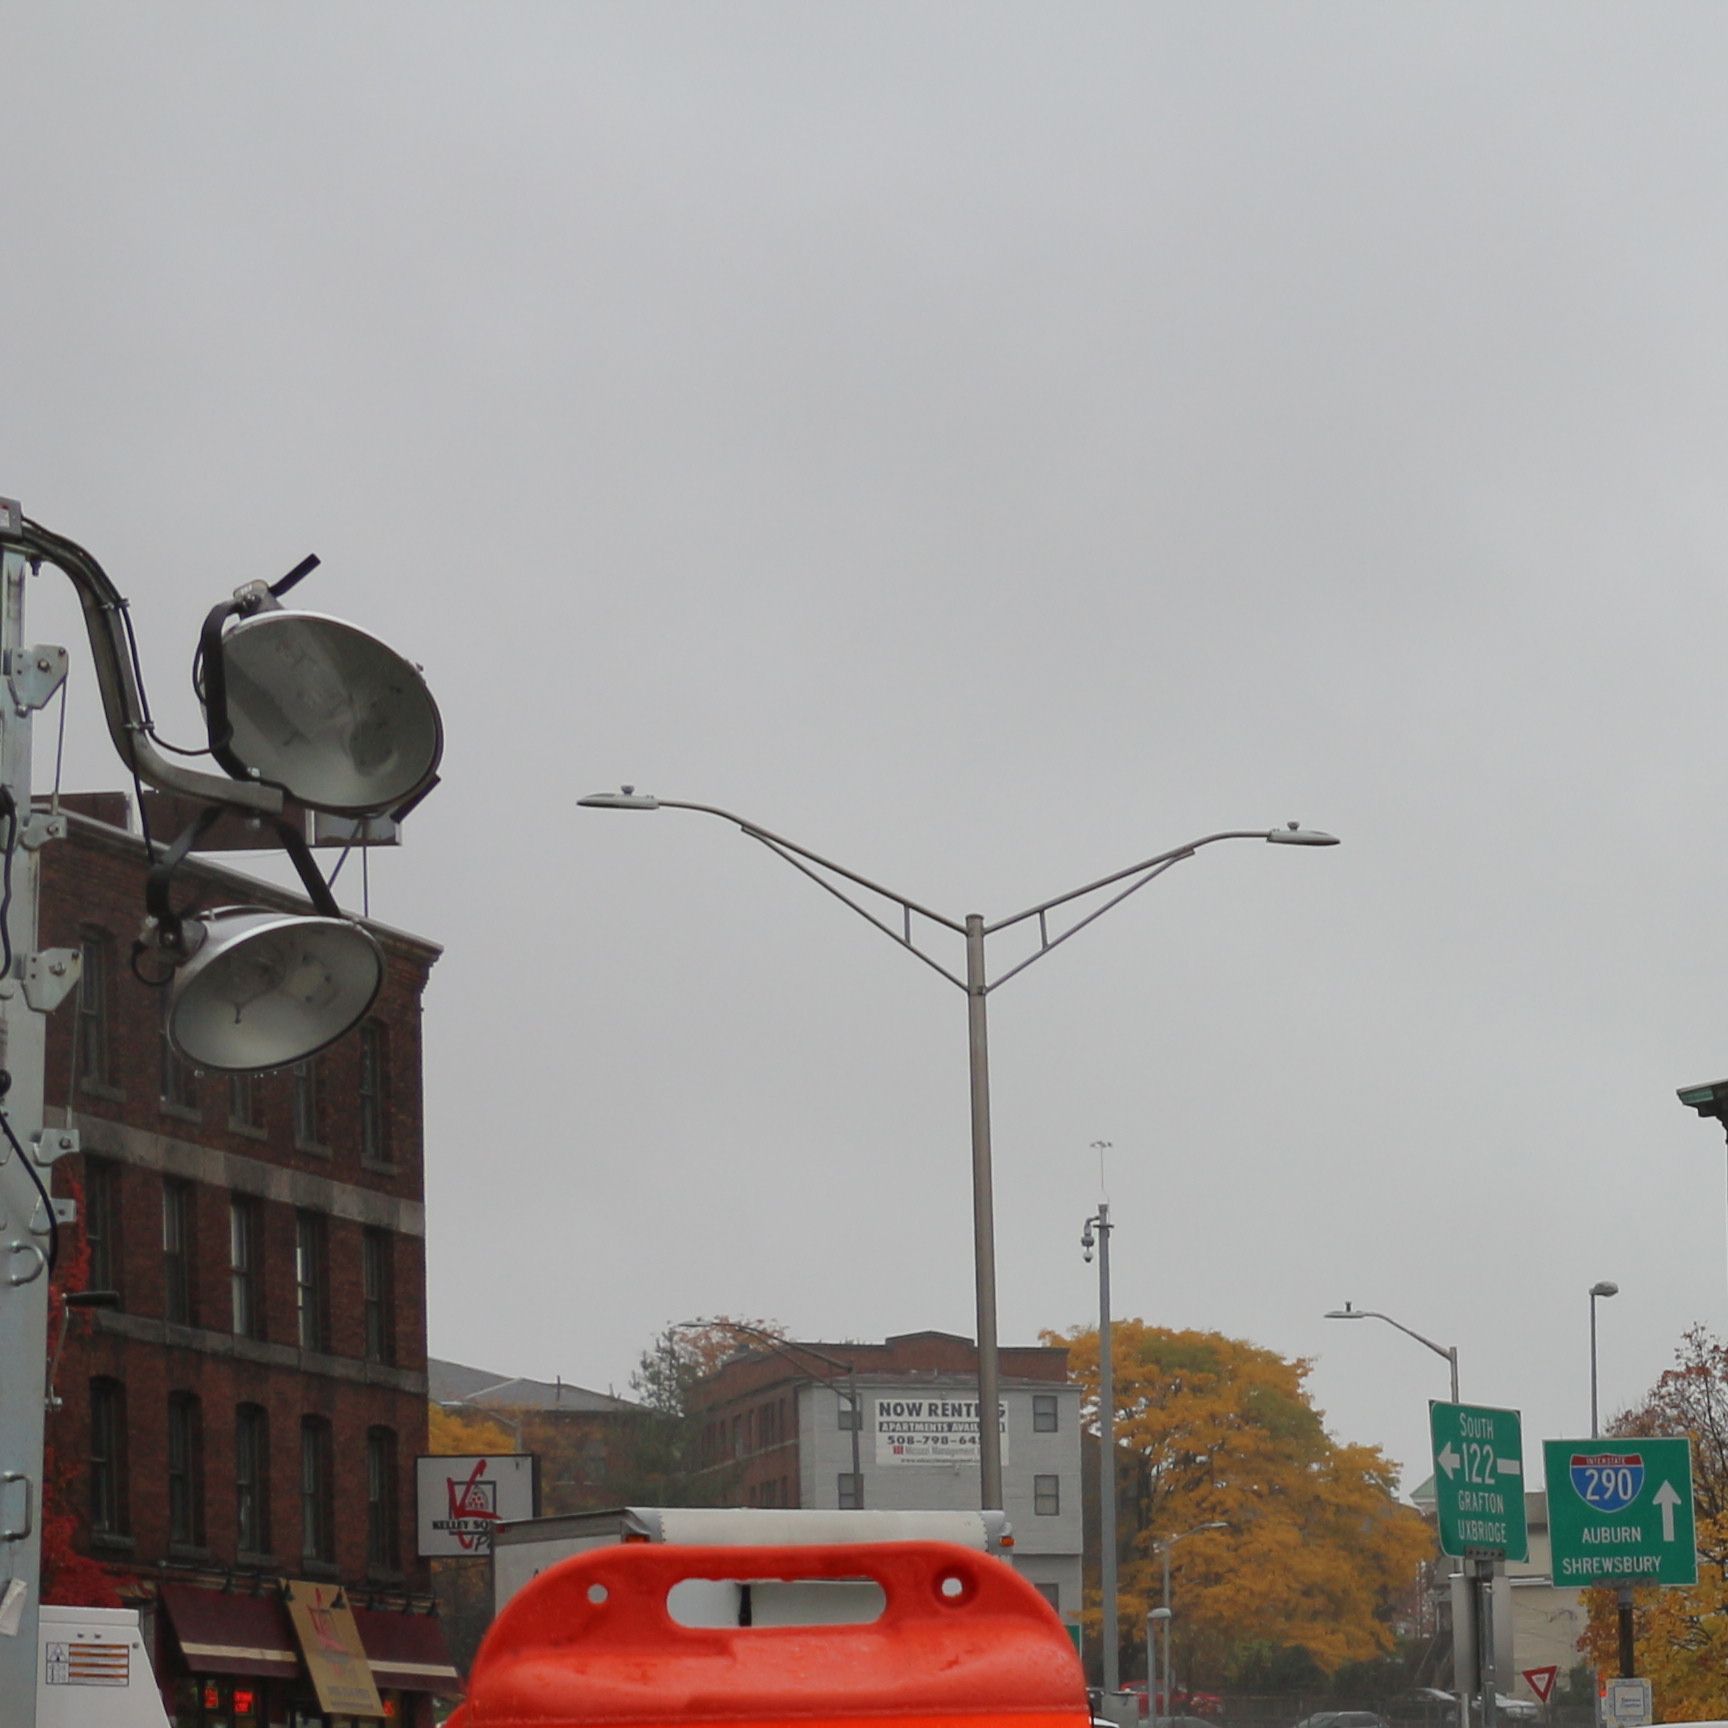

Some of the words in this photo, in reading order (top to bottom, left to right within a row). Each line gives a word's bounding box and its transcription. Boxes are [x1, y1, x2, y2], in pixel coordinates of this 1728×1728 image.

[879, 1402, 923, 1418] NOW
[928, 1402, 1006, 1418] RENTIG
[881, 1422, 948, 1432] APARTMENTS
[1459, 1412, 1495, 1440] SOUTH
[1462, 1442, 1495, 1484] 122
[1586, 1457, 1626, 1465] INTERSTATE
[1585, 1468, 1633, 1500] 290
[1458, 1490, 1504, 1514] GRAFTON
[433, 1521, 468, 1530] KELLEY
[1457, 1519, 1507, 1543] UXBRIDGE
[1582, 1526, 1641, 1543] AUBURN
[1562, 1556, 1661, 1574] SHREWSBURY
